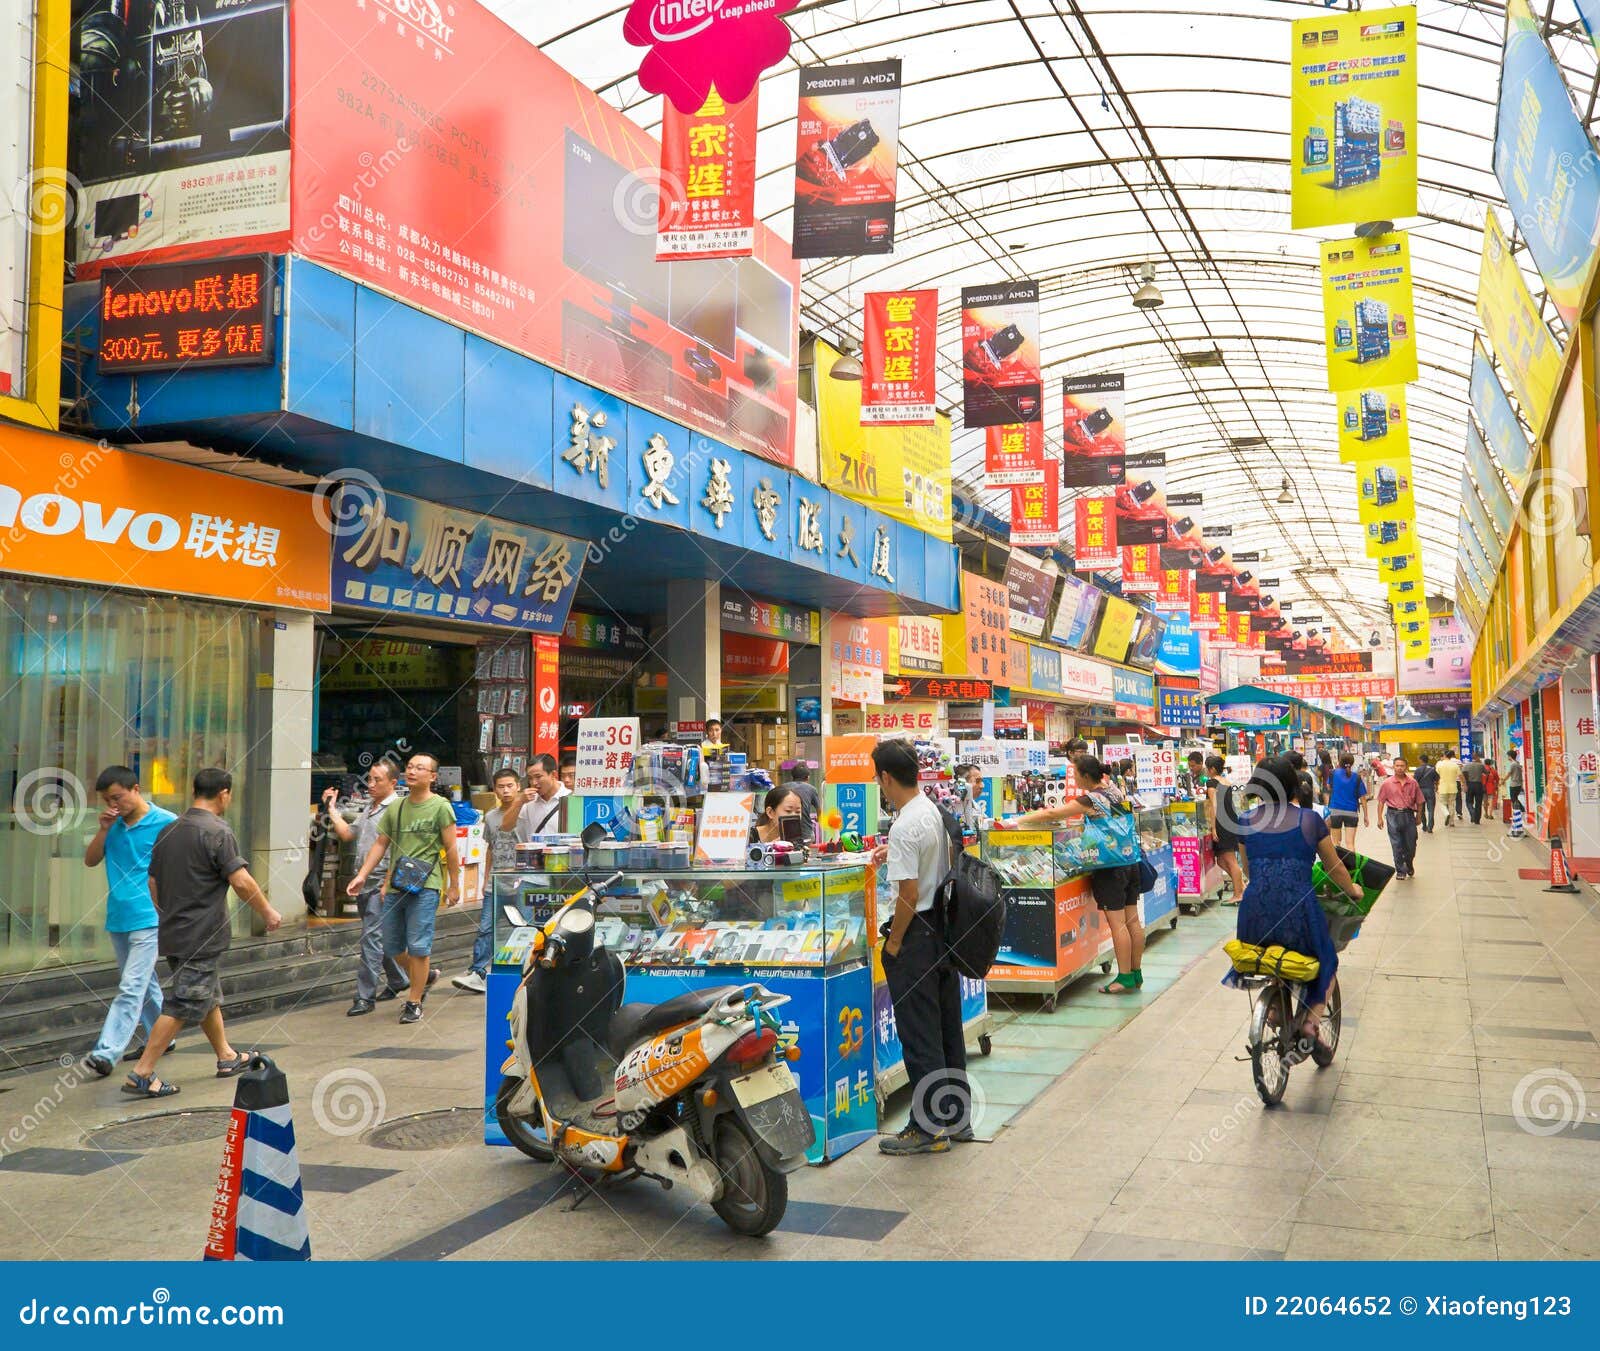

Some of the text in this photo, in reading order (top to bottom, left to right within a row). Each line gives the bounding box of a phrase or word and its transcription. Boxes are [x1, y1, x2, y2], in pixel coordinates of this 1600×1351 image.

[720, 0, 776, 20] Leap ahead
[883, 297, 917, 381] 管家婆
[343, 496, 574, 603] 加顺网络
[927, 680, 991, 699] 台式电脑
[866, 711, 933, 729] 活动专区
[606, 725, 633, 746] 3G
[1576, 716, 1597, 772] 佳能
[605, 751, 633, 770] 资费
[1105, 747, 1132, 758] 笔记本
[1151, 750, 1173, 764] 3G
[846, 812, 859, 830] 2
[838, 1005, 864, 1059] 3G
[834, 1068, 869, 1119] 网卡
